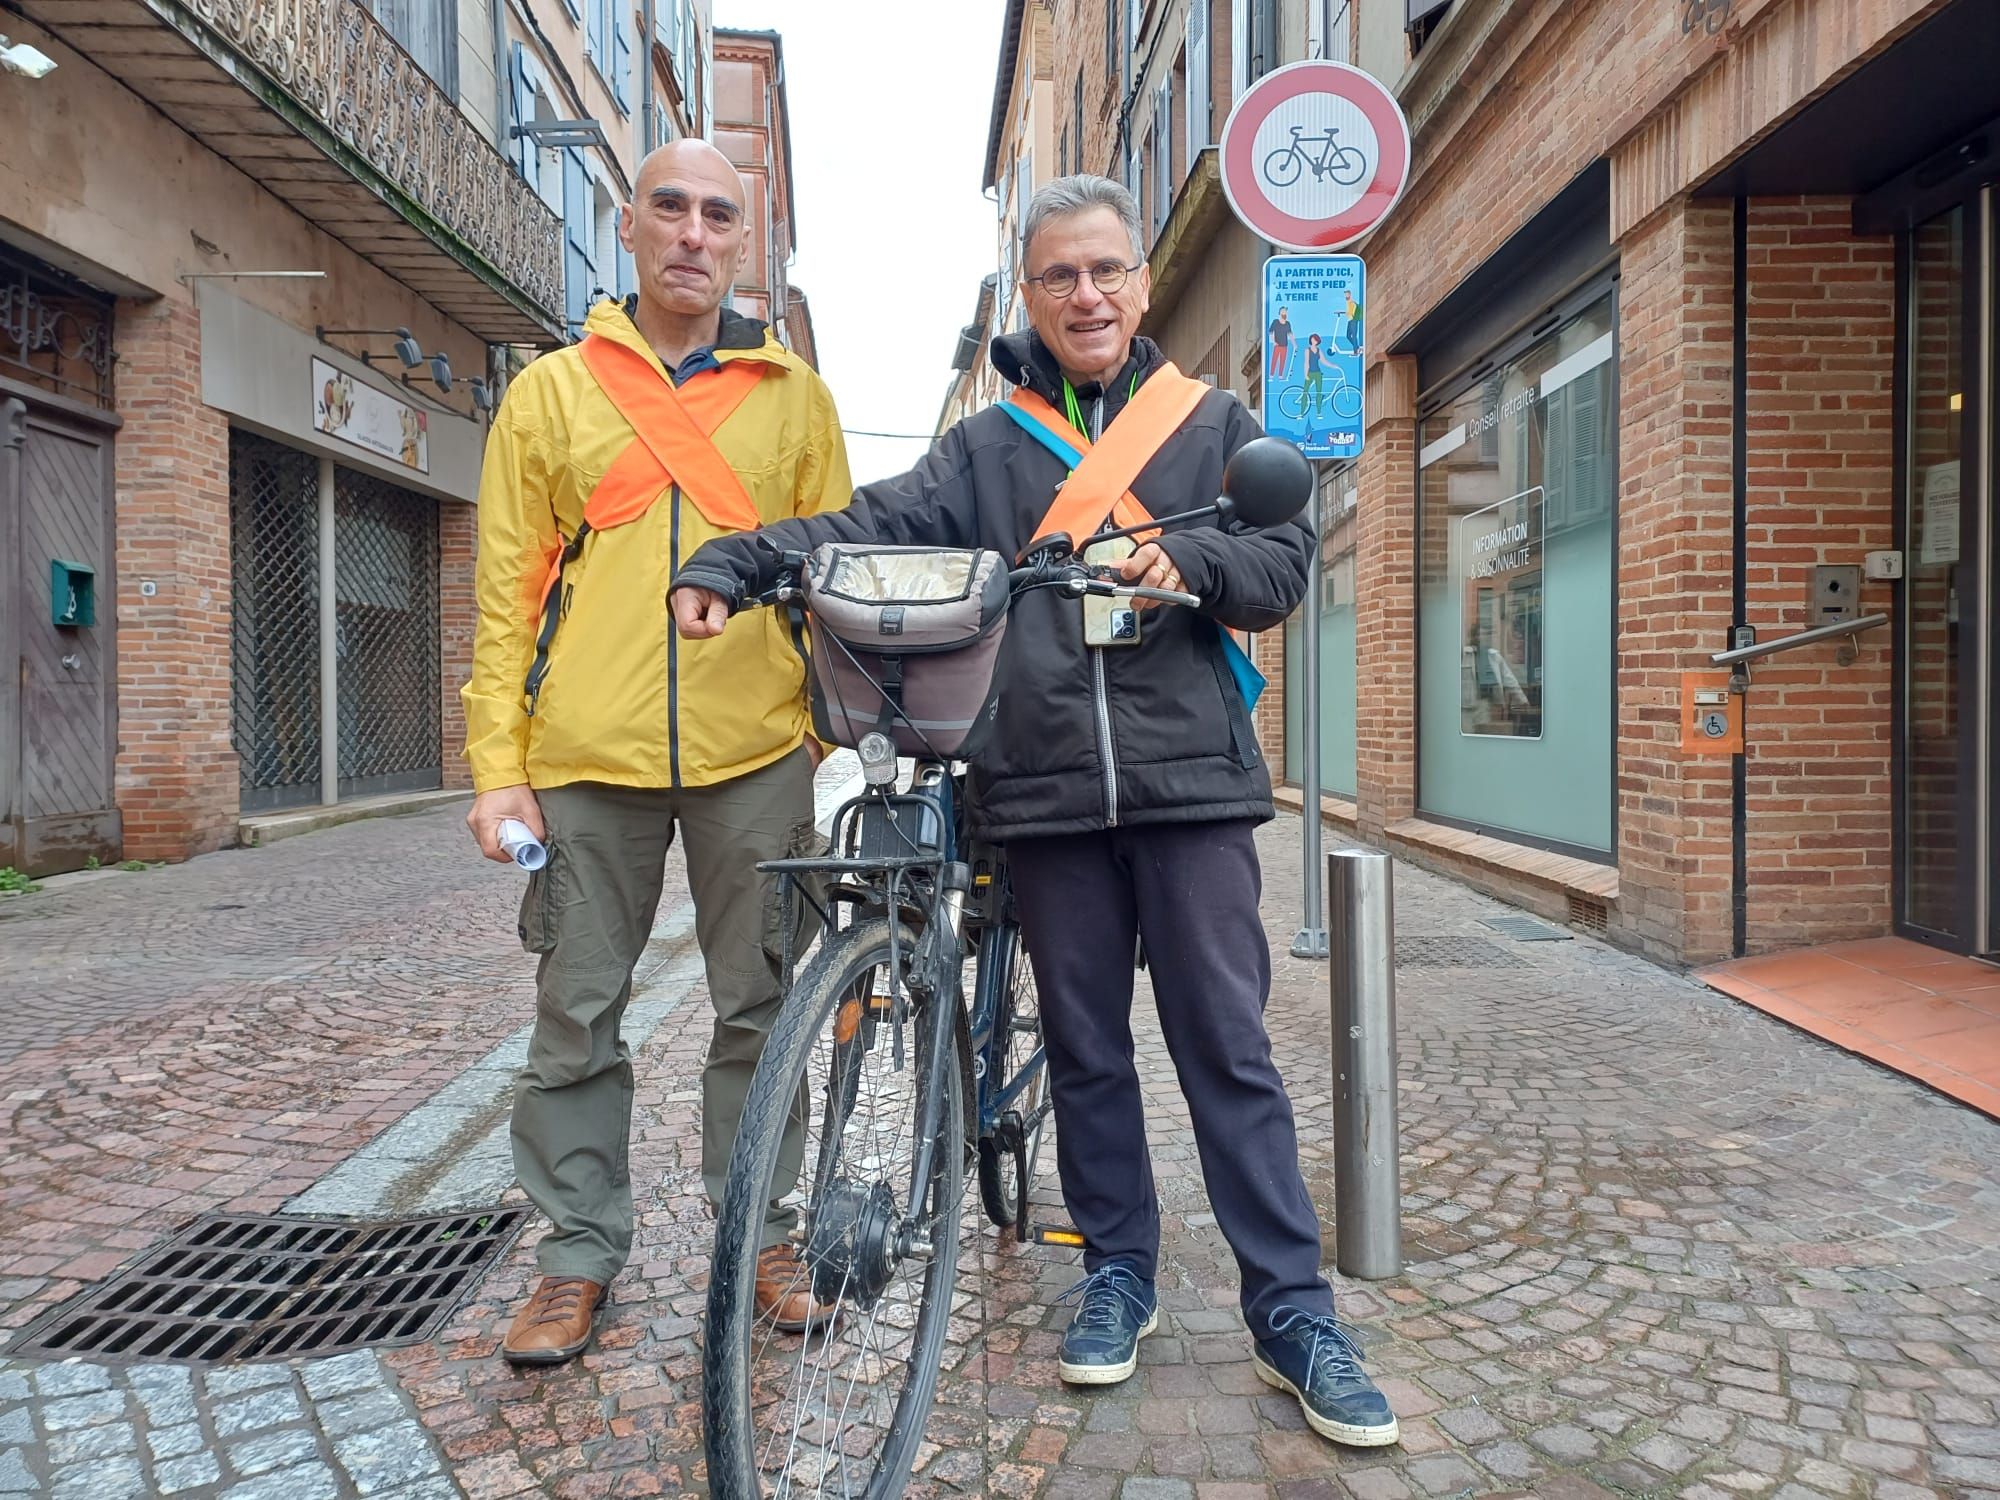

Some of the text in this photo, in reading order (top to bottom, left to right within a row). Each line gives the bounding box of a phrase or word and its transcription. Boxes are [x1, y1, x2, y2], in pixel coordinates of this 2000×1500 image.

[1285, 268, 1324, 277] PARTIR
[1326, 267, 1354, 277] D'ICI,
[1275, 280, 1346, 289] JE METS PIED
[1284, 292, 1318, 301] TERRE
[1470, 386, 1535, 438] Conseil retraite
[1472, 521, 1528, 555] INFORMATION
[1471, 542, 1530, 580] & SAISONNALITÉ
